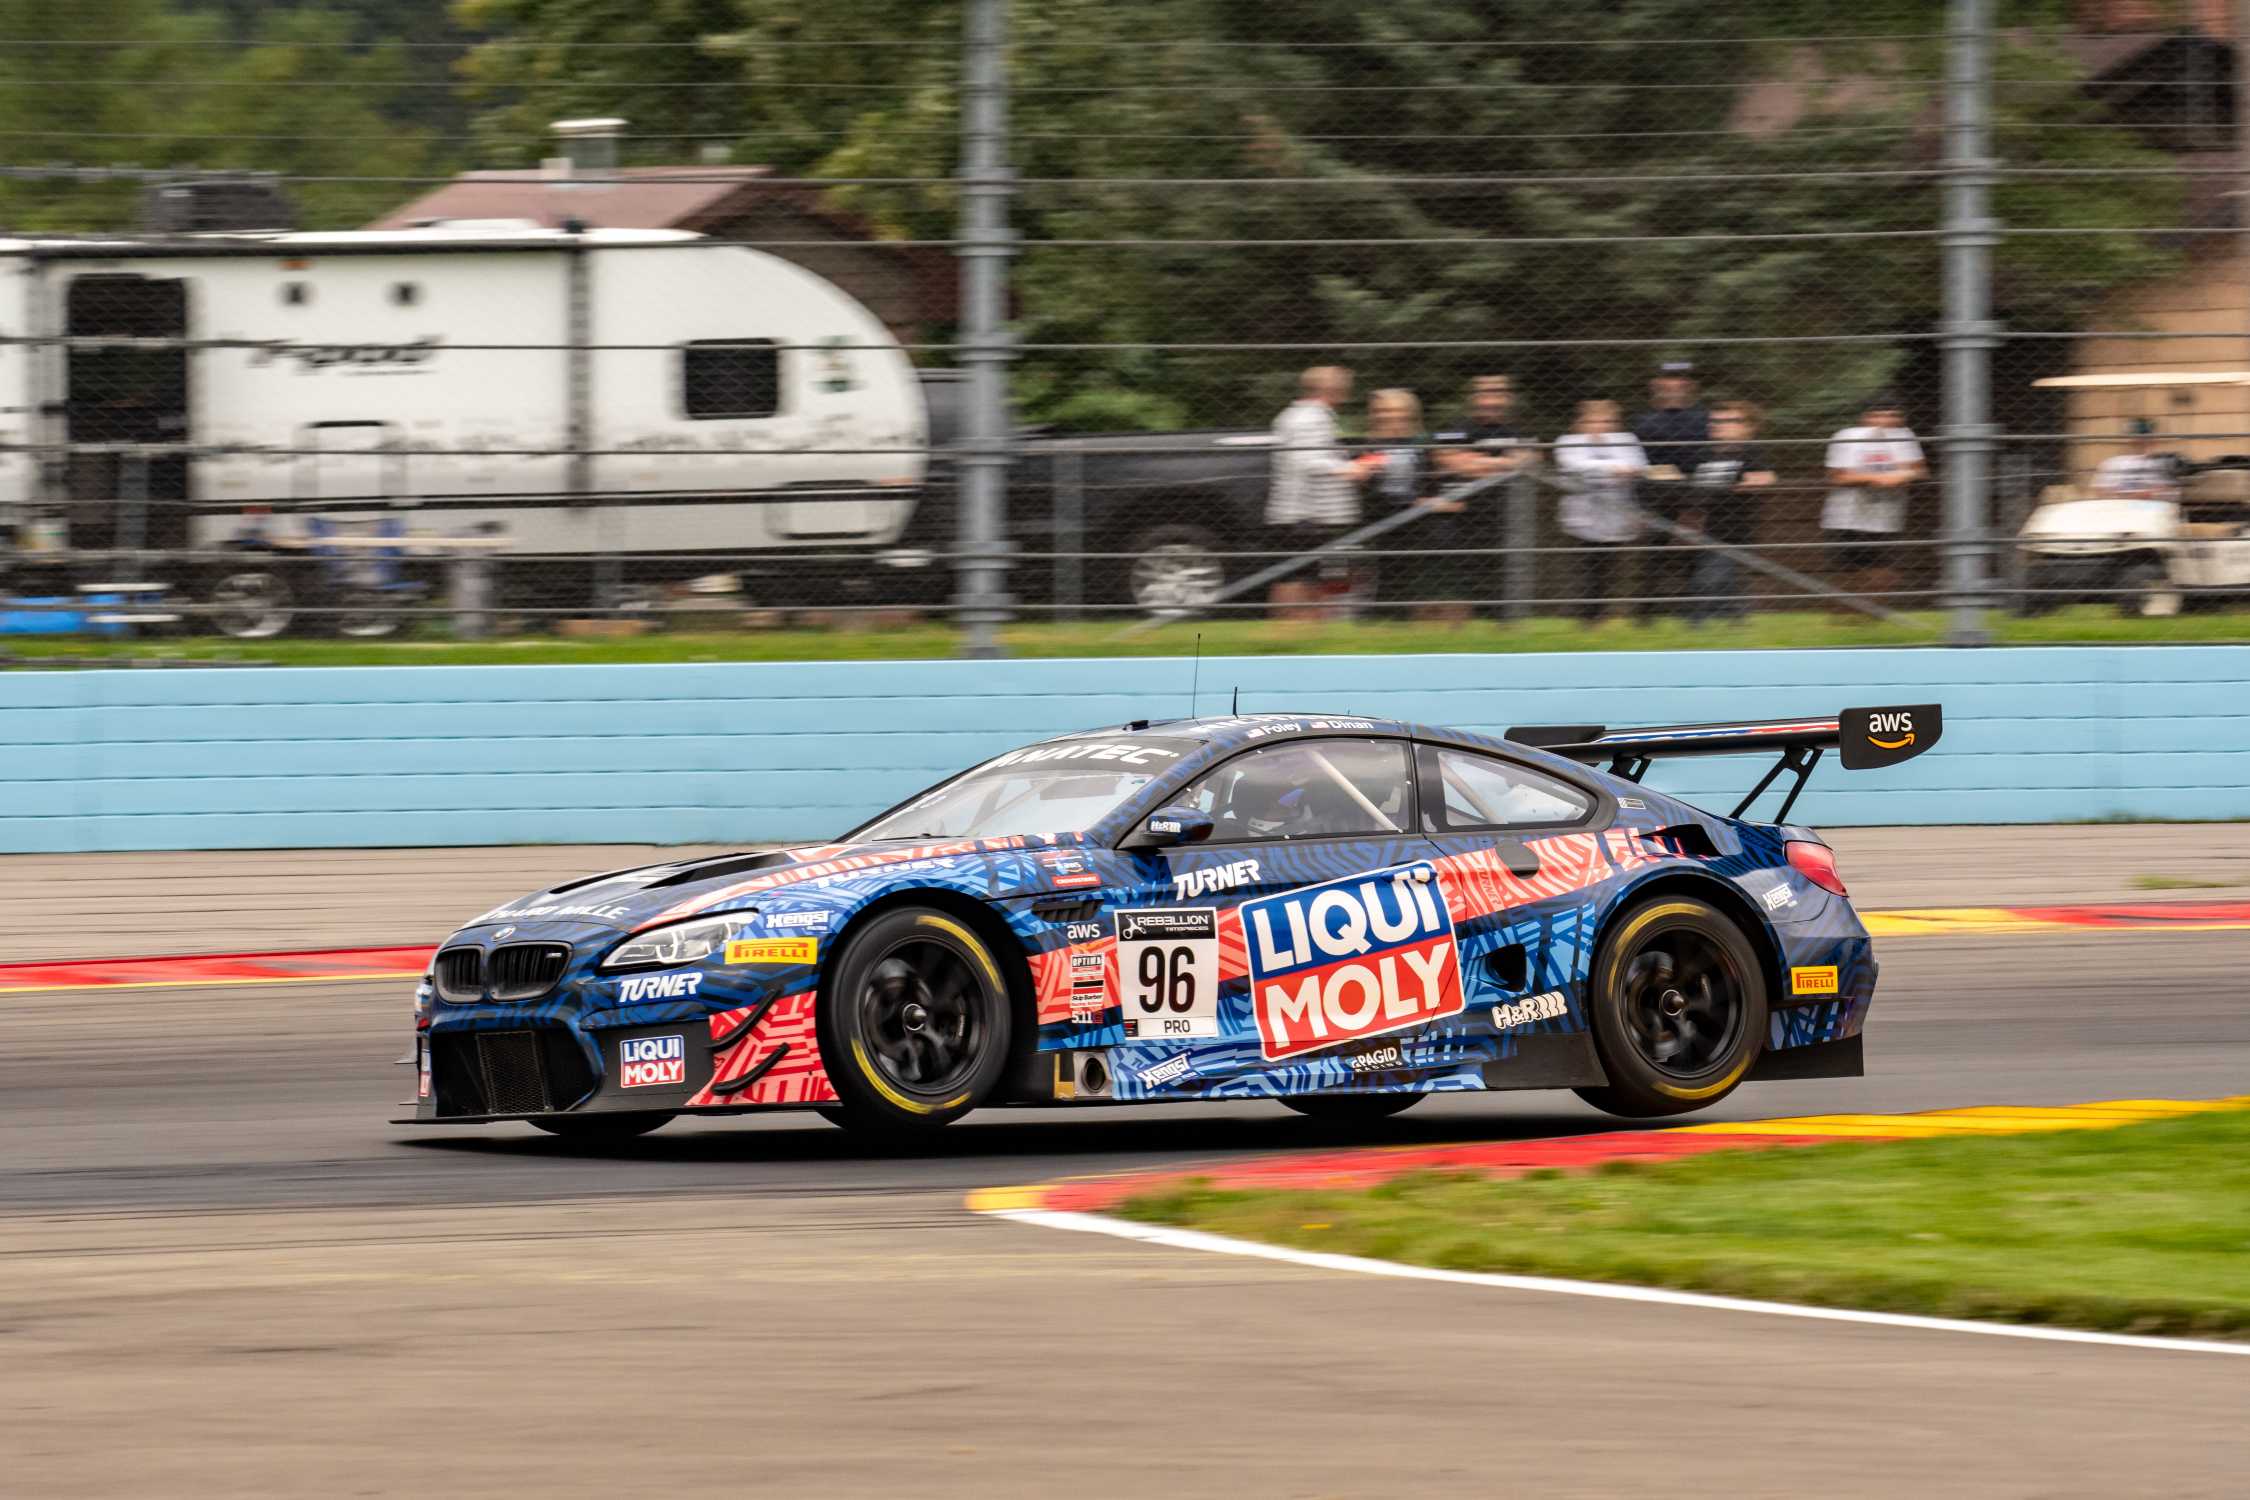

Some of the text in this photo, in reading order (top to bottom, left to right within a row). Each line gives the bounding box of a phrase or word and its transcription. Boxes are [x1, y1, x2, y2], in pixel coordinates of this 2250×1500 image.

[1263, 721, 1302, 735] Foley
[1328, 720, 1375, 730] Dinan
[1869, 712, 1913, 733] aws
[1173, 859, 1261, 902] TURNER
[1252, 868, 1441, 972] LIQUI
[1067, 923, 1101, 939] aws
[733, 941, 809, 959] PIRELLI
[619, 972, 703, 1003] TURNER
[1139, 946, 1195, 1013] 96
[1796, 972, 1834, 989] PIRELLI
[1265, 942, 1451, 1049] MOLY
[1164, 1020, 1191, 1033] PRO
[623, 1038, 680, 1062] LIQUI
[1357, 1047, 1397, 1067] PAGID
[625, 1060, 682, 1085] MOLY
